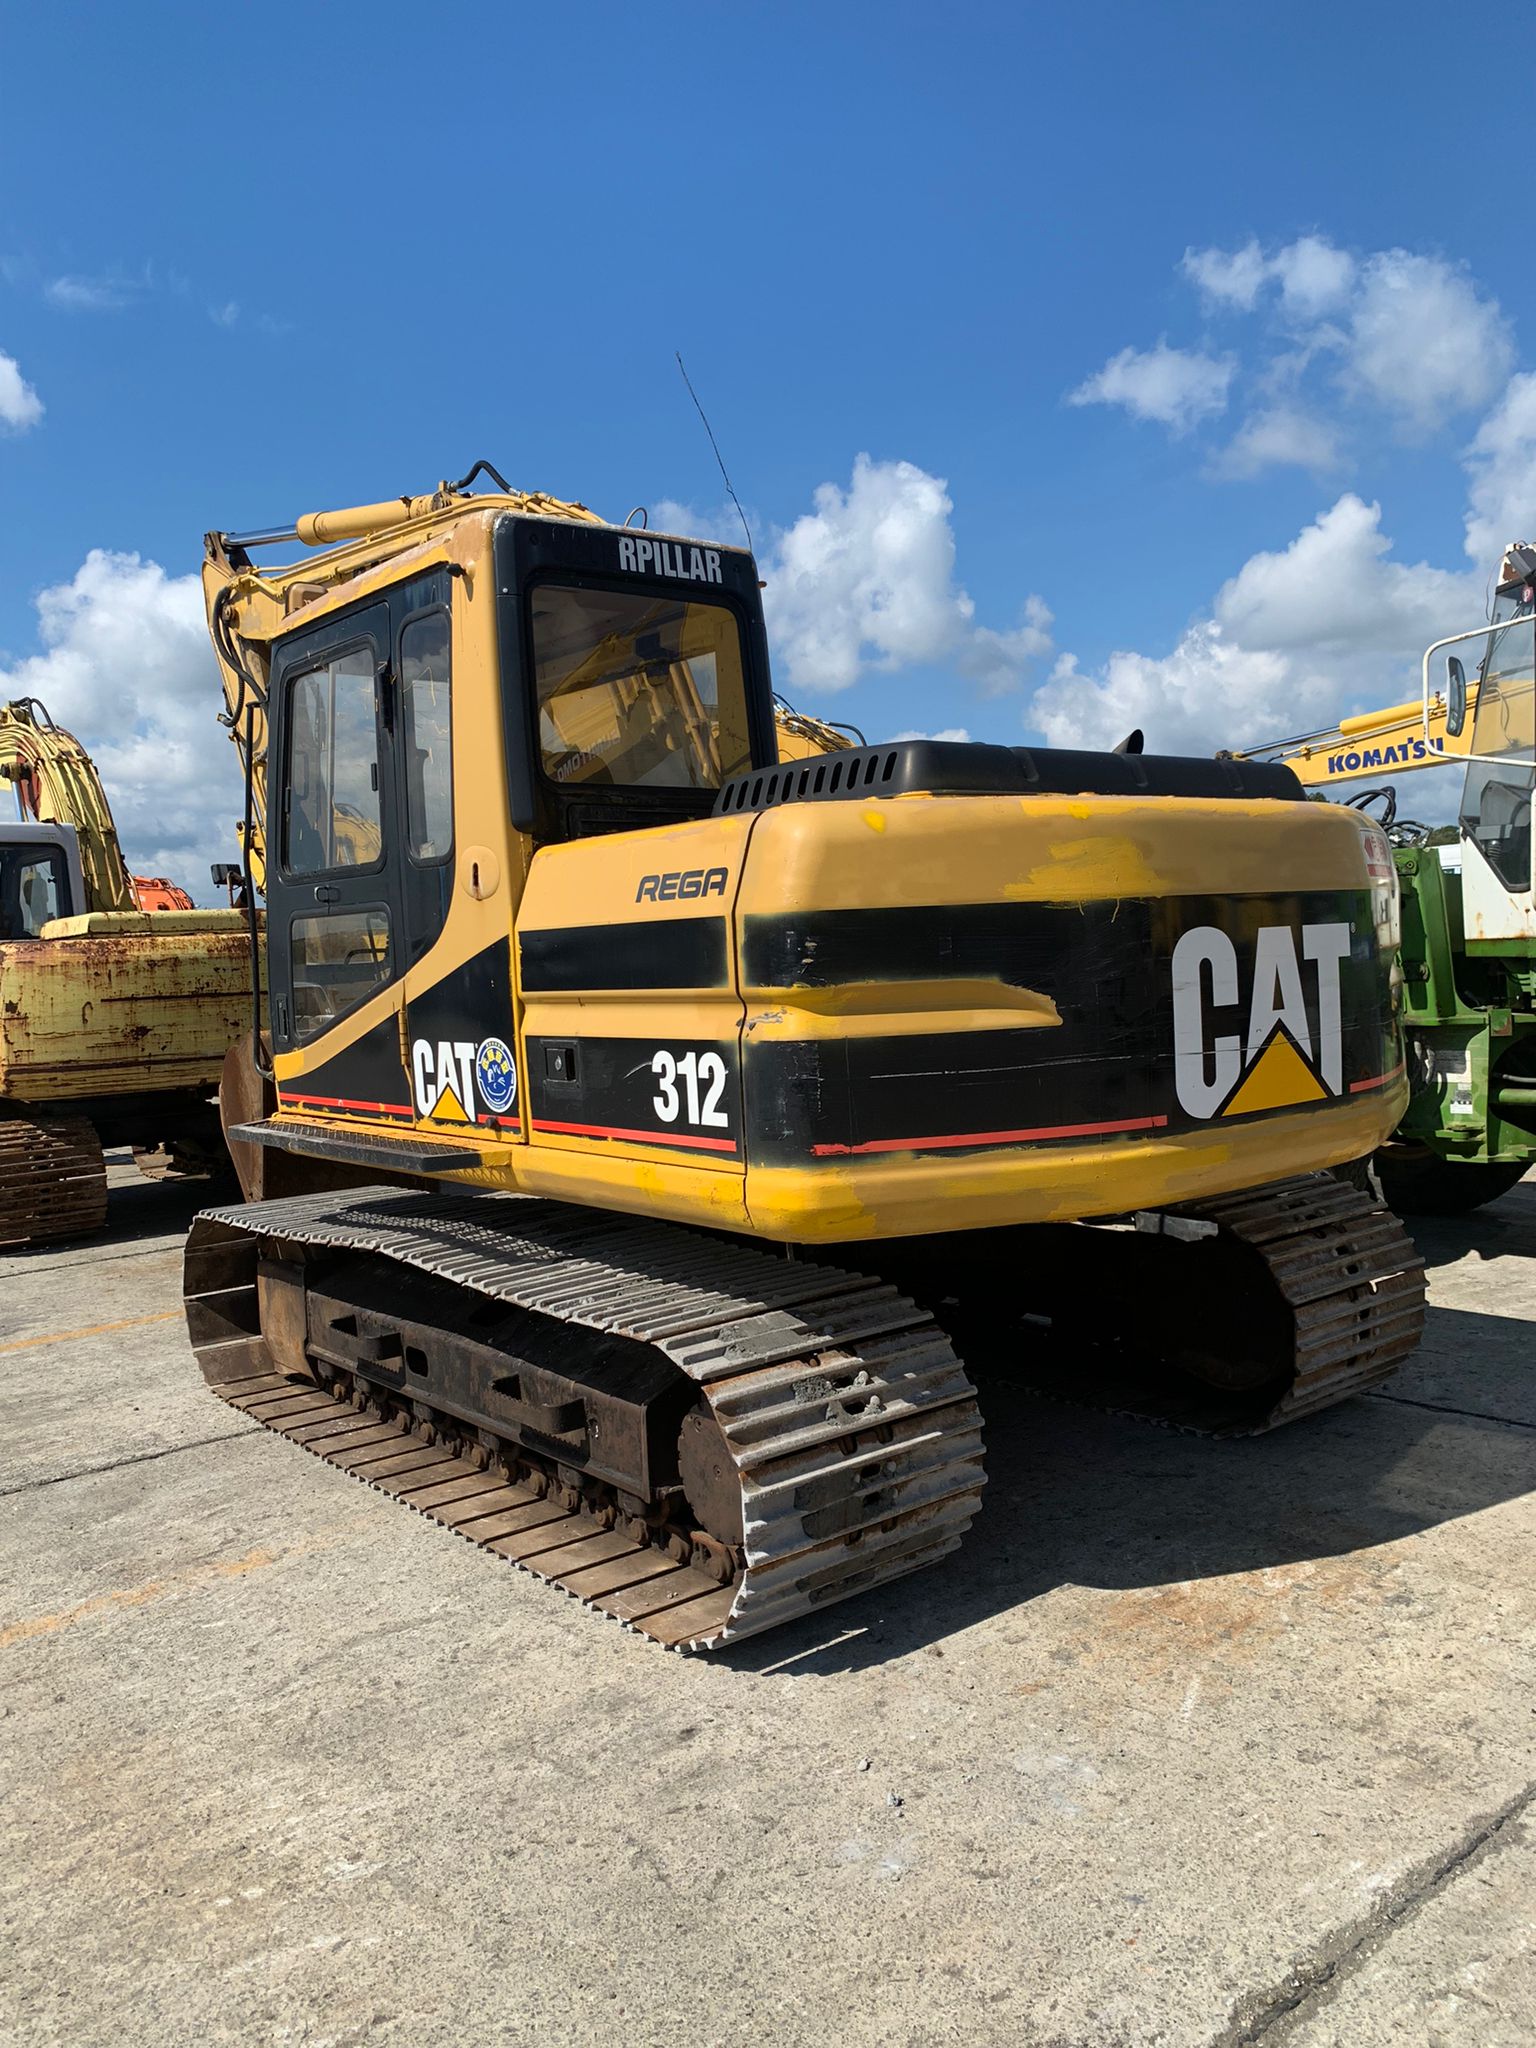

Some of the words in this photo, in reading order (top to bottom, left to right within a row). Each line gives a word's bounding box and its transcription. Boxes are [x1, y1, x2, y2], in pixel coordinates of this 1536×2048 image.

[618, 536, 723, 584] RPILLAR
[1328, 737, 1444, 774] KOMATSU
[635, 867, 728, 903] REGA
[1172, 922, 1351, 1119] CAT
[413, 1039, 476, 1122] CAT
[652, 1050, 729, 1127] 312
